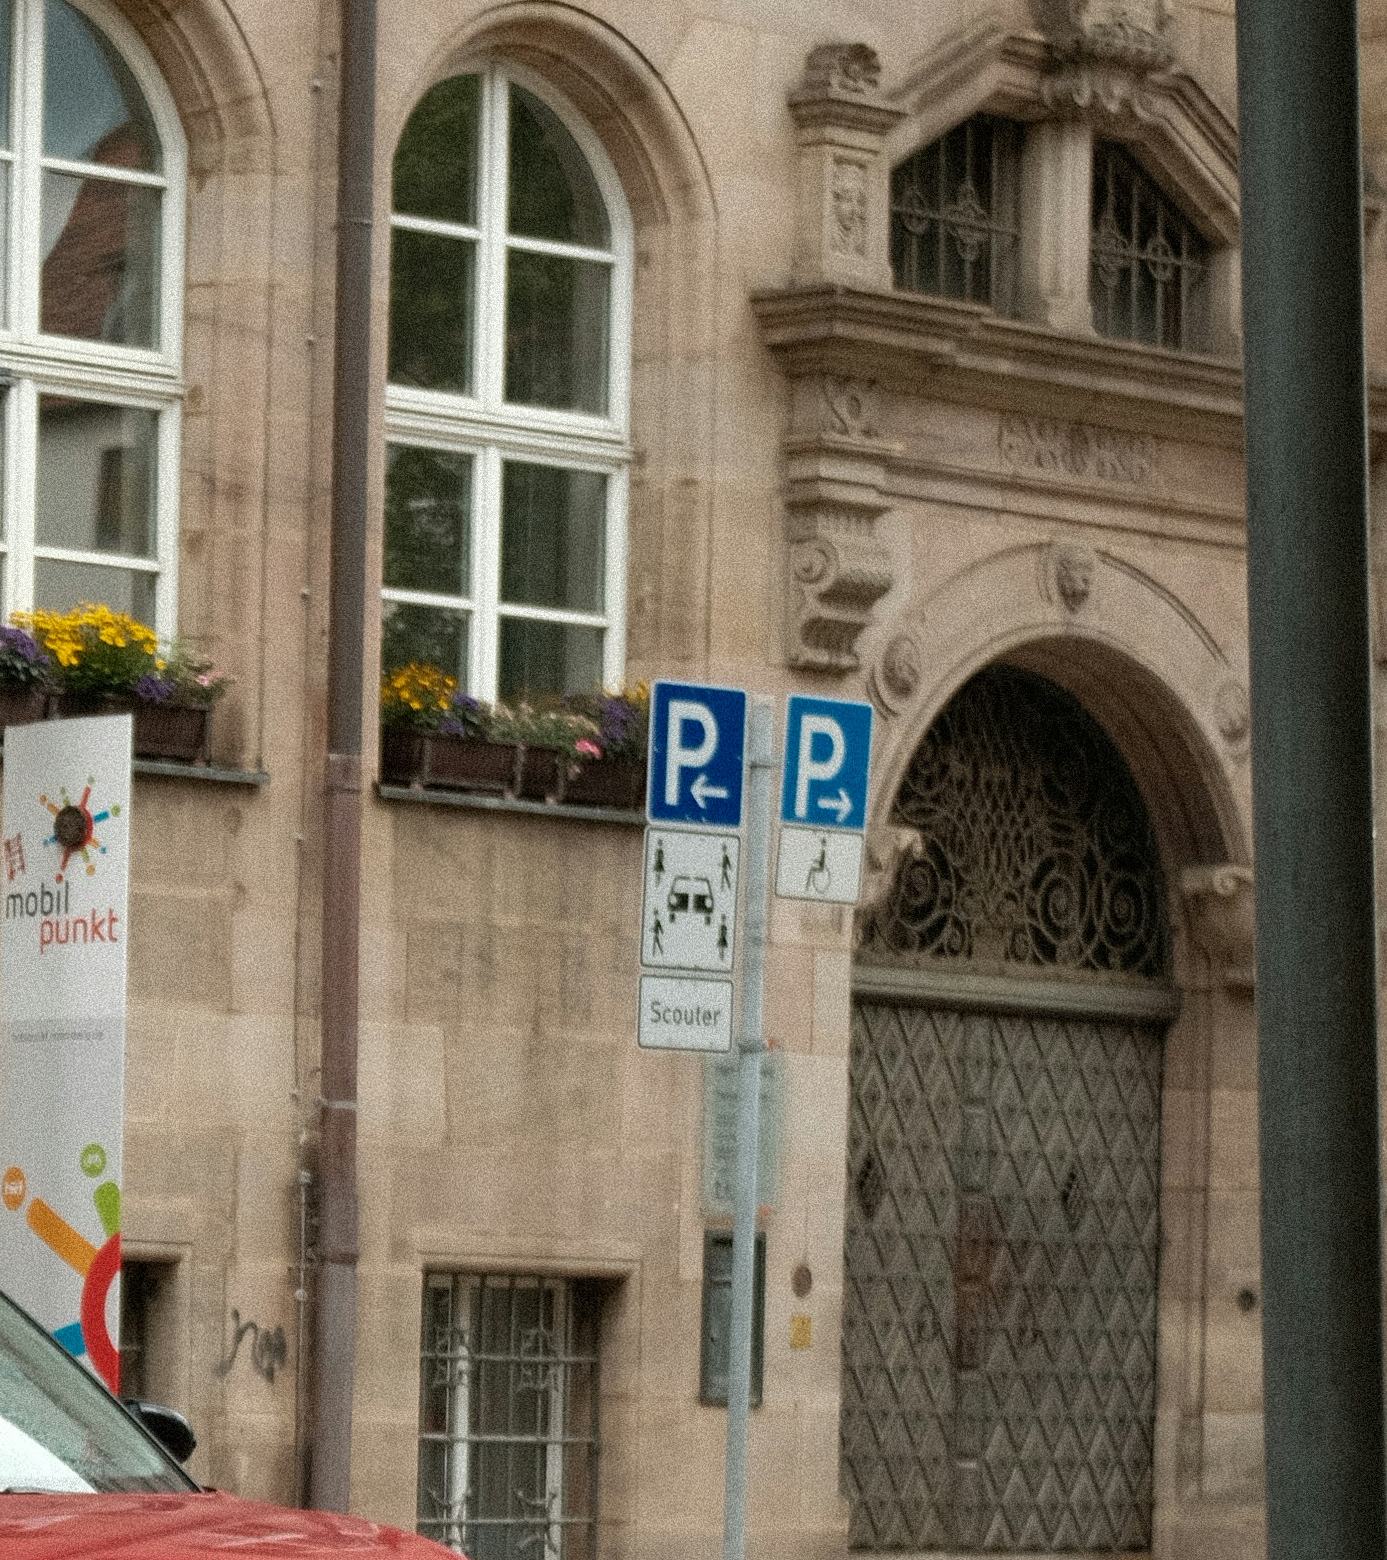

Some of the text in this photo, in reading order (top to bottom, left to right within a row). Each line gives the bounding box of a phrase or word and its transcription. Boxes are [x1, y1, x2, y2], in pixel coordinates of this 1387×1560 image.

[664, 698, 720, 806] P
[794, 713, 846, 818] P
[6, 880, 69, 919] mobil
[40, 908, 118, 955] punkt
[650, 1001, 721, 1026] Scouter
